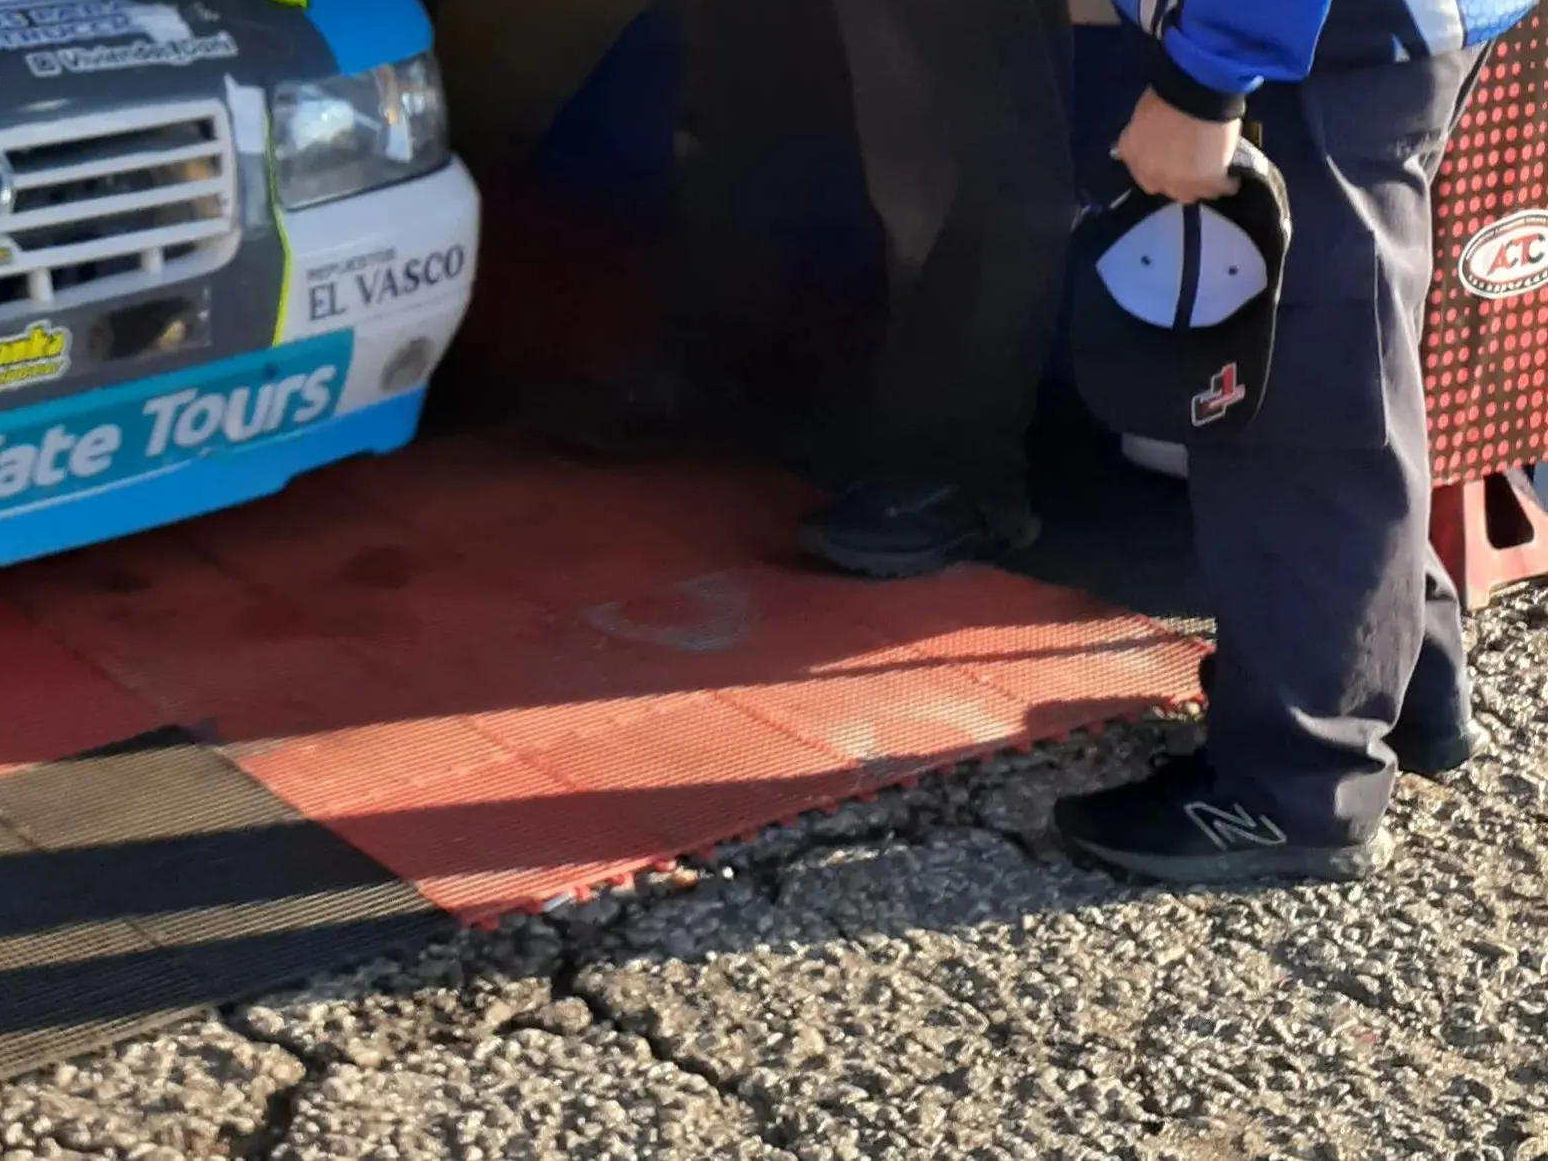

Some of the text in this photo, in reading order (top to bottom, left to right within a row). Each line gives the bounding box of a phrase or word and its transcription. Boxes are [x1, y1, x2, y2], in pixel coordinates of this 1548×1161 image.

[307, 244, 466, 321] EL VASCO
[141, 365, 337, 458] Tours
